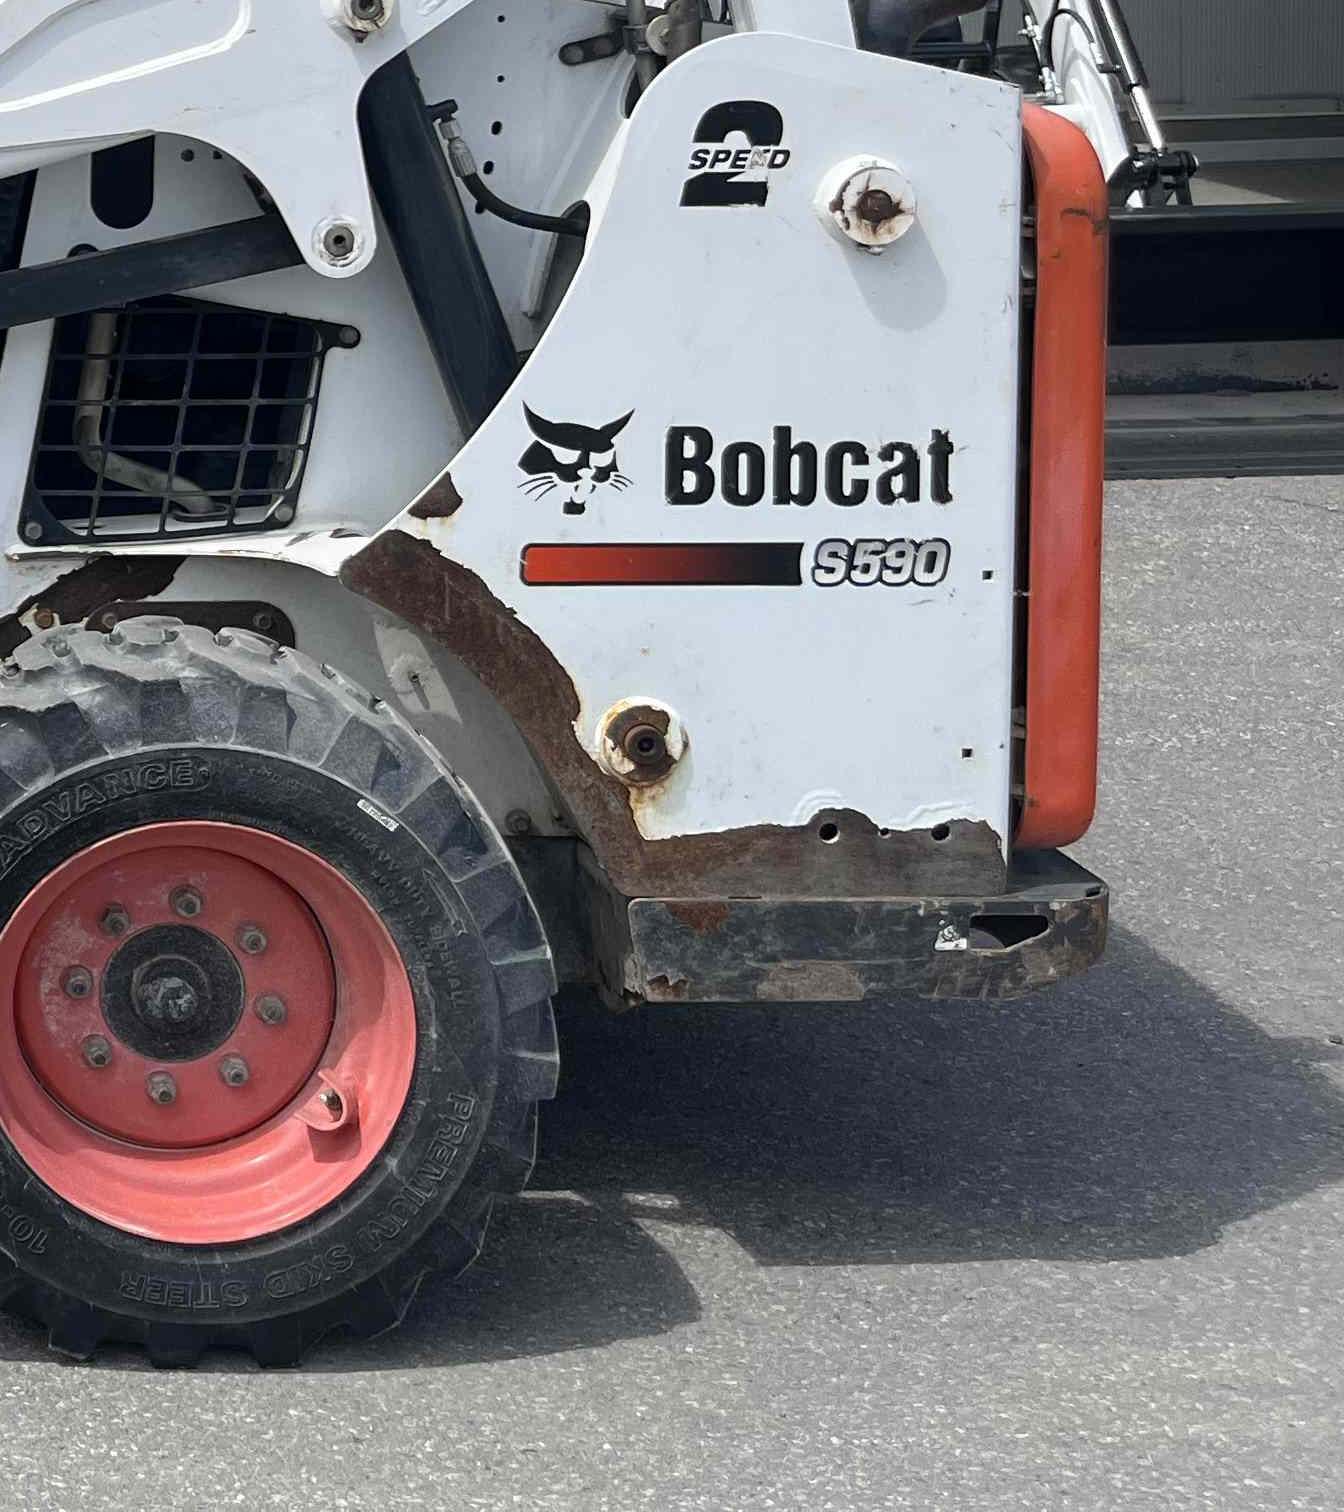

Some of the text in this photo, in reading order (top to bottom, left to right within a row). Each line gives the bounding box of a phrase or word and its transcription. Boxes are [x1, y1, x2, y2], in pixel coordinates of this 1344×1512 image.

[680, 100, 783, 207] 2
[688, 149, 791, 170] SPED
[665, 425, 954, 507] Bobcat
[812, 537, 952, 587] S590
[120, 1092, 479, 1310] PREMIUM SKID STEER
